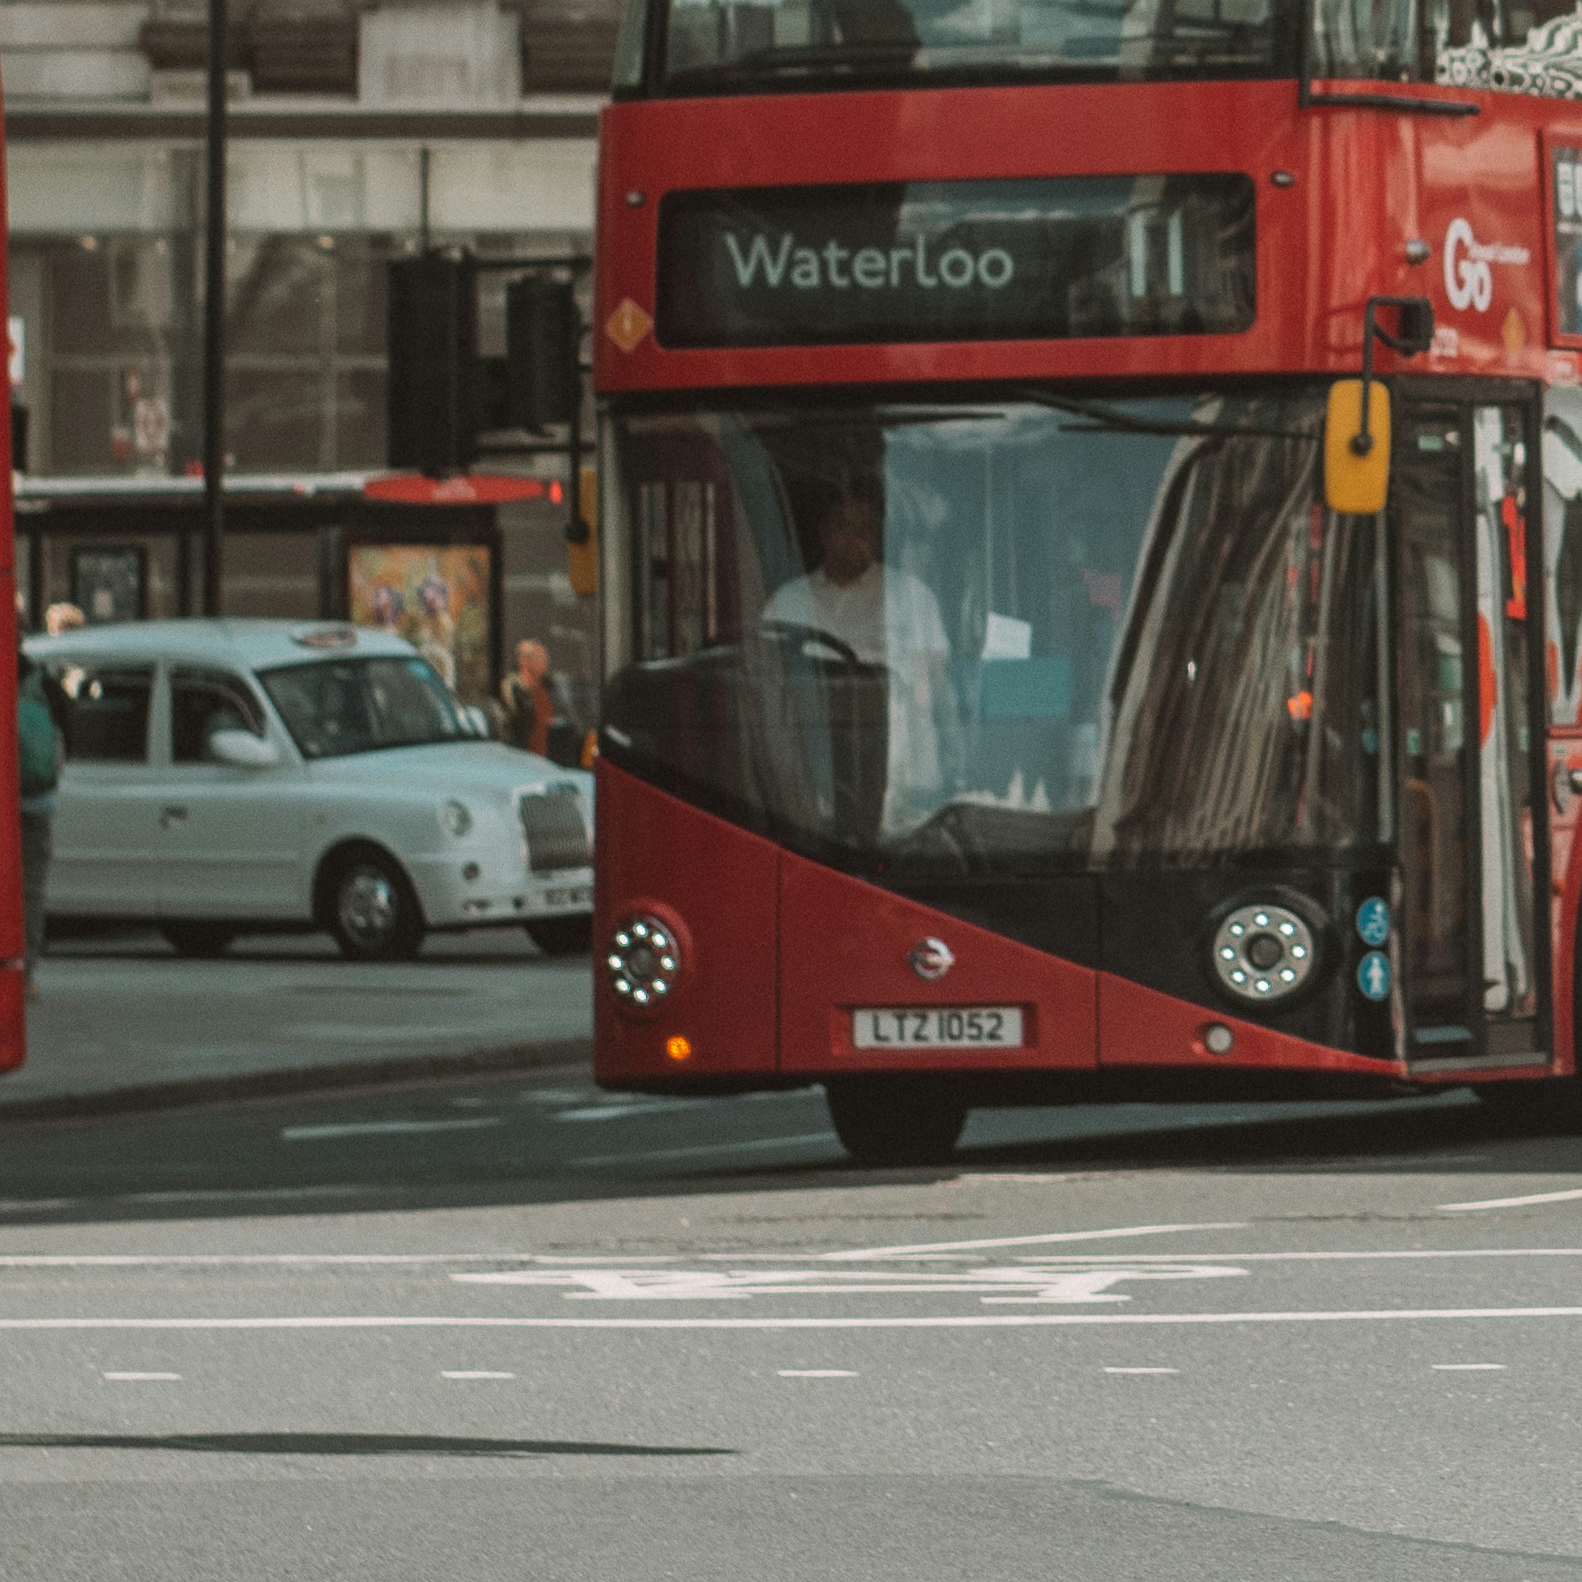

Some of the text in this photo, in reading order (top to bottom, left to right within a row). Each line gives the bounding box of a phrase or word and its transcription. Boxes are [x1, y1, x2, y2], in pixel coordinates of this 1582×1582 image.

[724, 211, 1183, 297] Waterloo 11
[872, 1011, 1003, 1042] LTZ 1052
